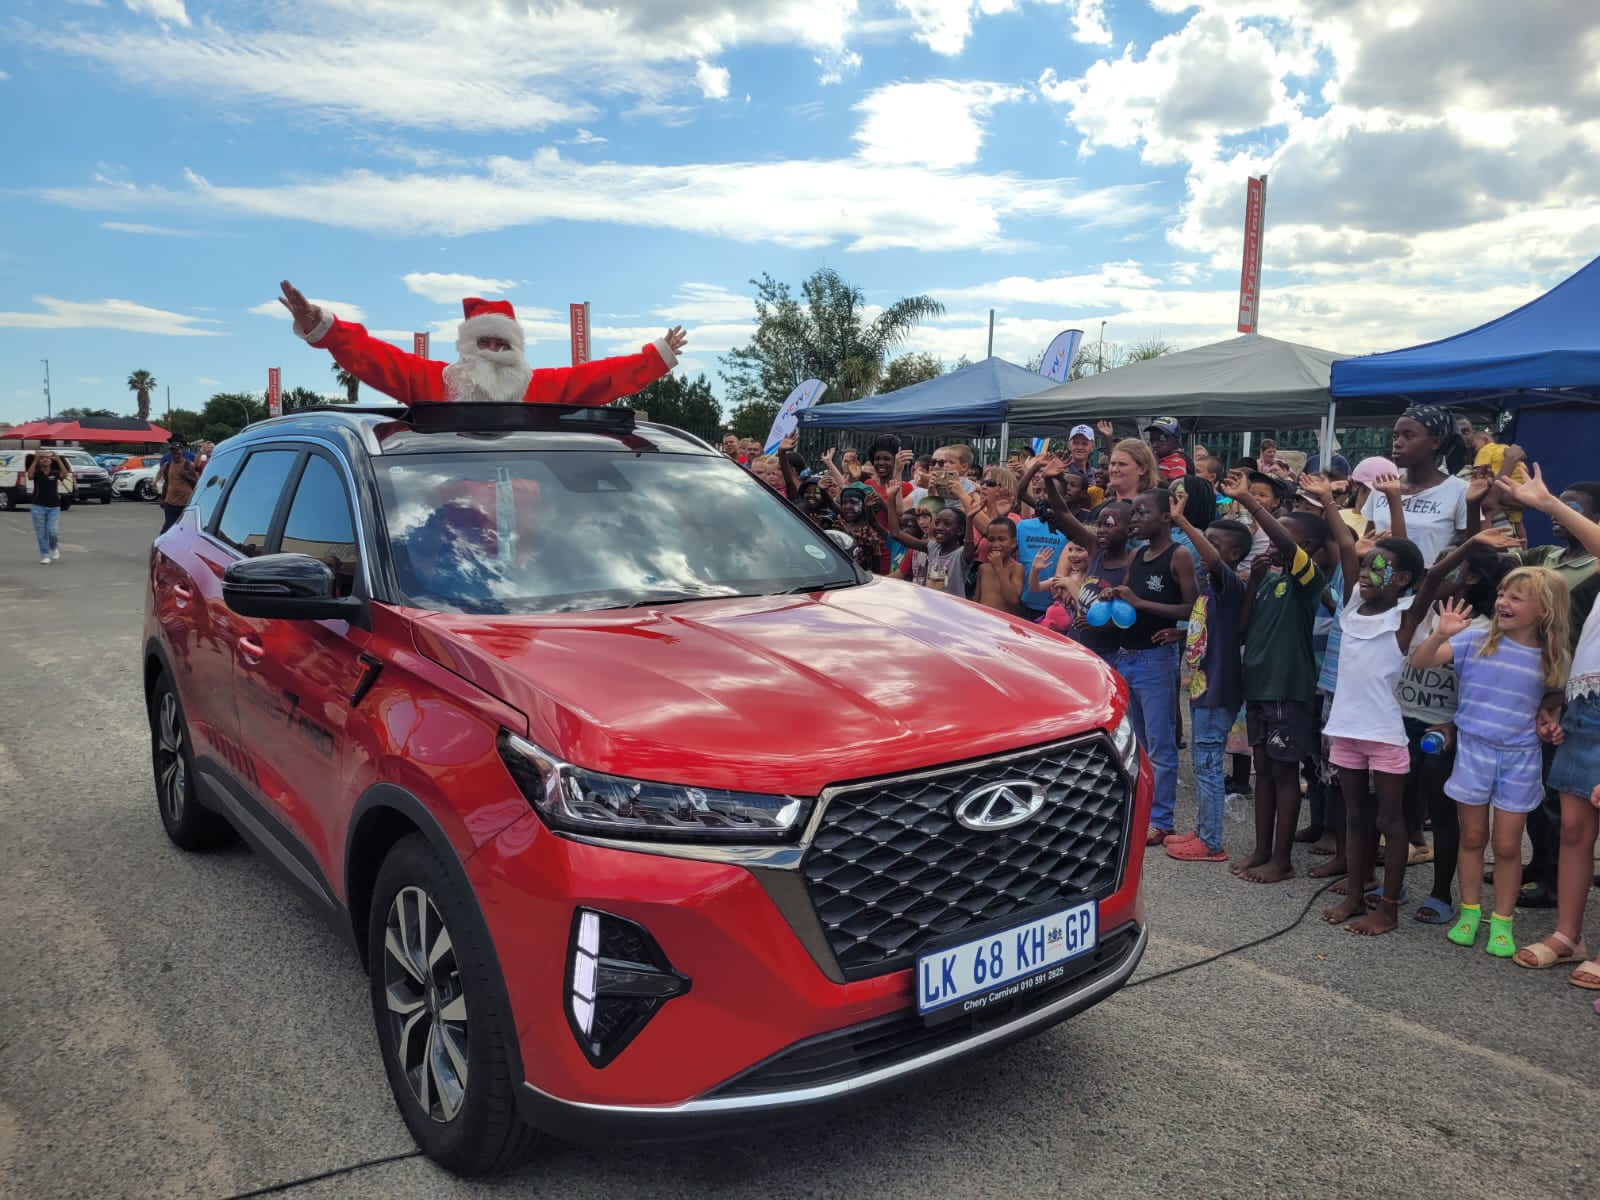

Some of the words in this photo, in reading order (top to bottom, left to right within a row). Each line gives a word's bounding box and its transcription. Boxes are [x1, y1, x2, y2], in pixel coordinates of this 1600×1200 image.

[1402, 498, 1441, 514] LEEK.
[1402, 663, 1455, 692] INDA
[1395, 682, 1448, 707] ON'T
[924, 954, 957, 1003] LK
[973, 940, 1003, 985] 68
[1016, 925, 1045, 971] KH
[1065, 908, 1091, 952] GP
[963, 996, 988, 1010] Chery
[988, 983, 1019, 1003] Carnival
[1020, 980, 1033, 992] 010
[1034, 974, 1047, 986] 591
